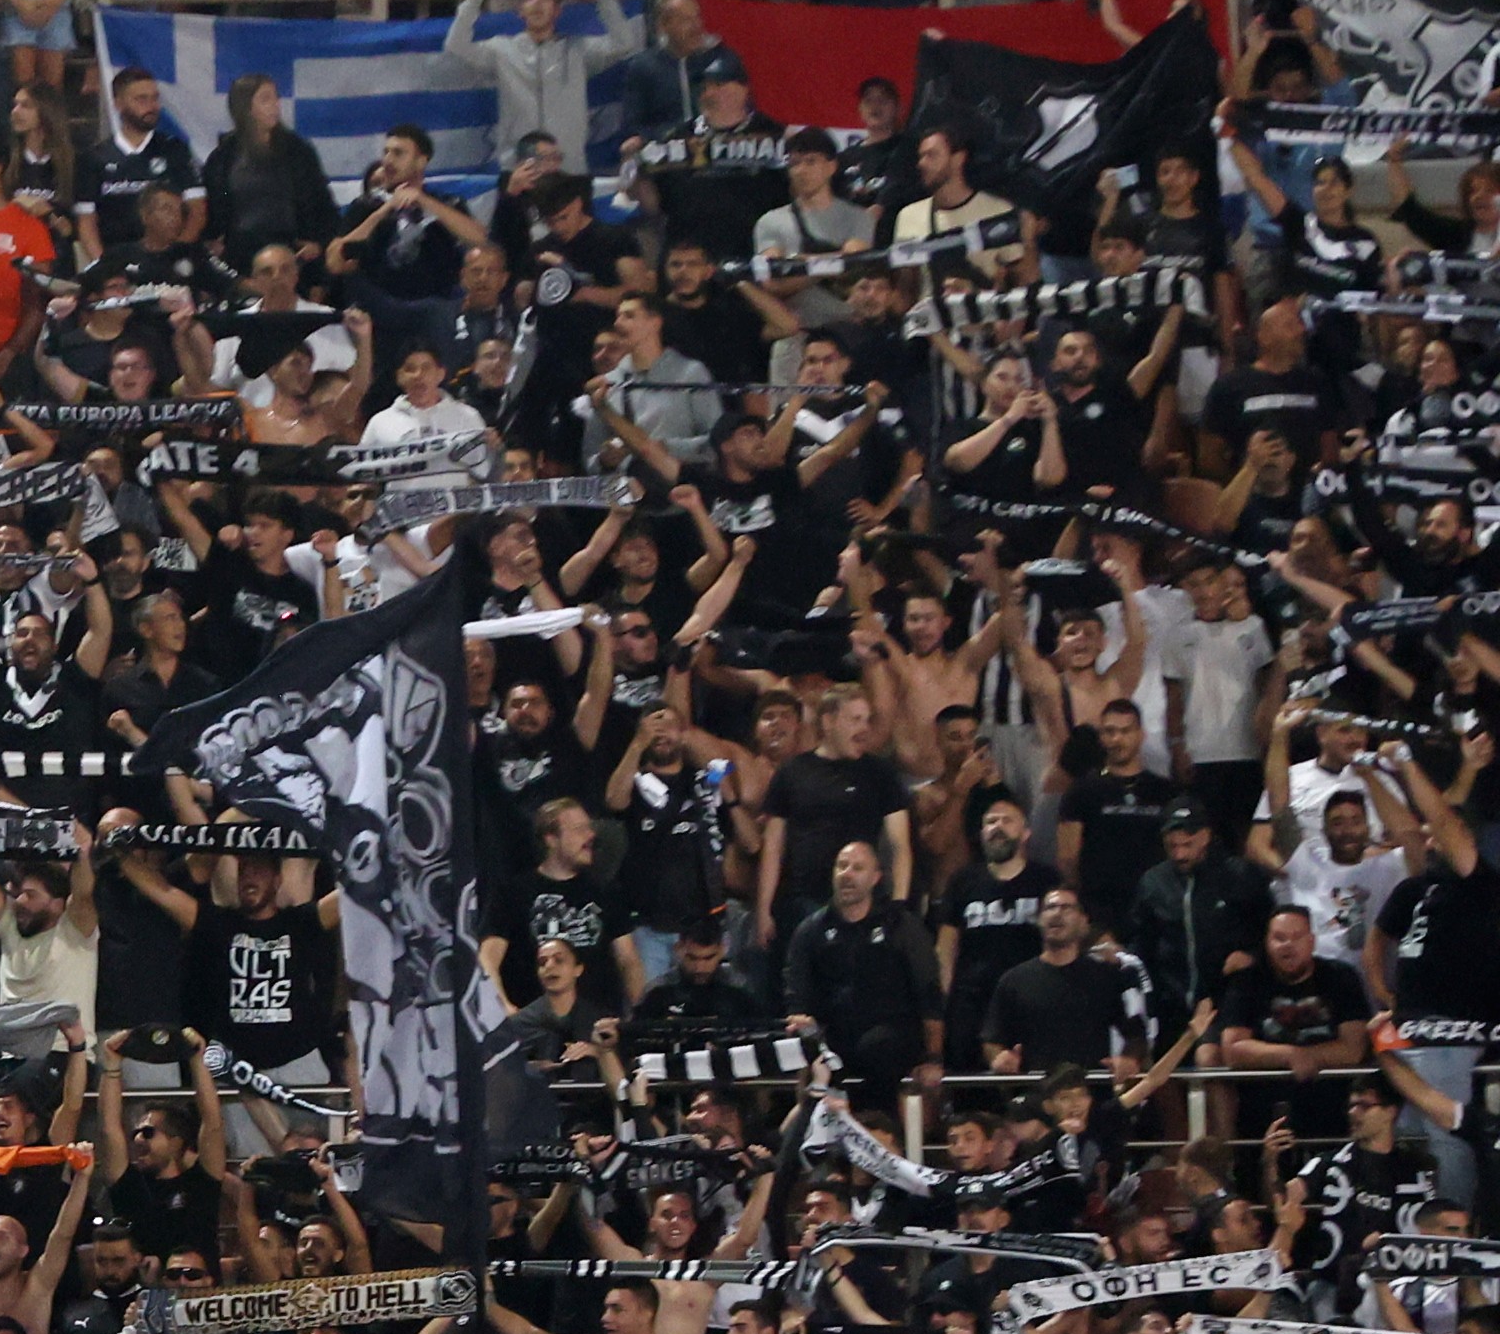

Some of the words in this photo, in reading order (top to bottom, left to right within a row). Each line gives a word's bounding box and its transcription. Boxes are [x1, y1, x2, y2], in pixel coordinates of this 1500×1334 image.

[228, 947, 292, 981] ULT
[230, 977, 290, 1008] RAS
[184, 1291, 289, 1321] WELCOME
[329, 1290, 363, 1312] TO
[368, 1281, 427, 1308] HELL
[1070, 1266, 1163, 1303] ΟΦΗ
